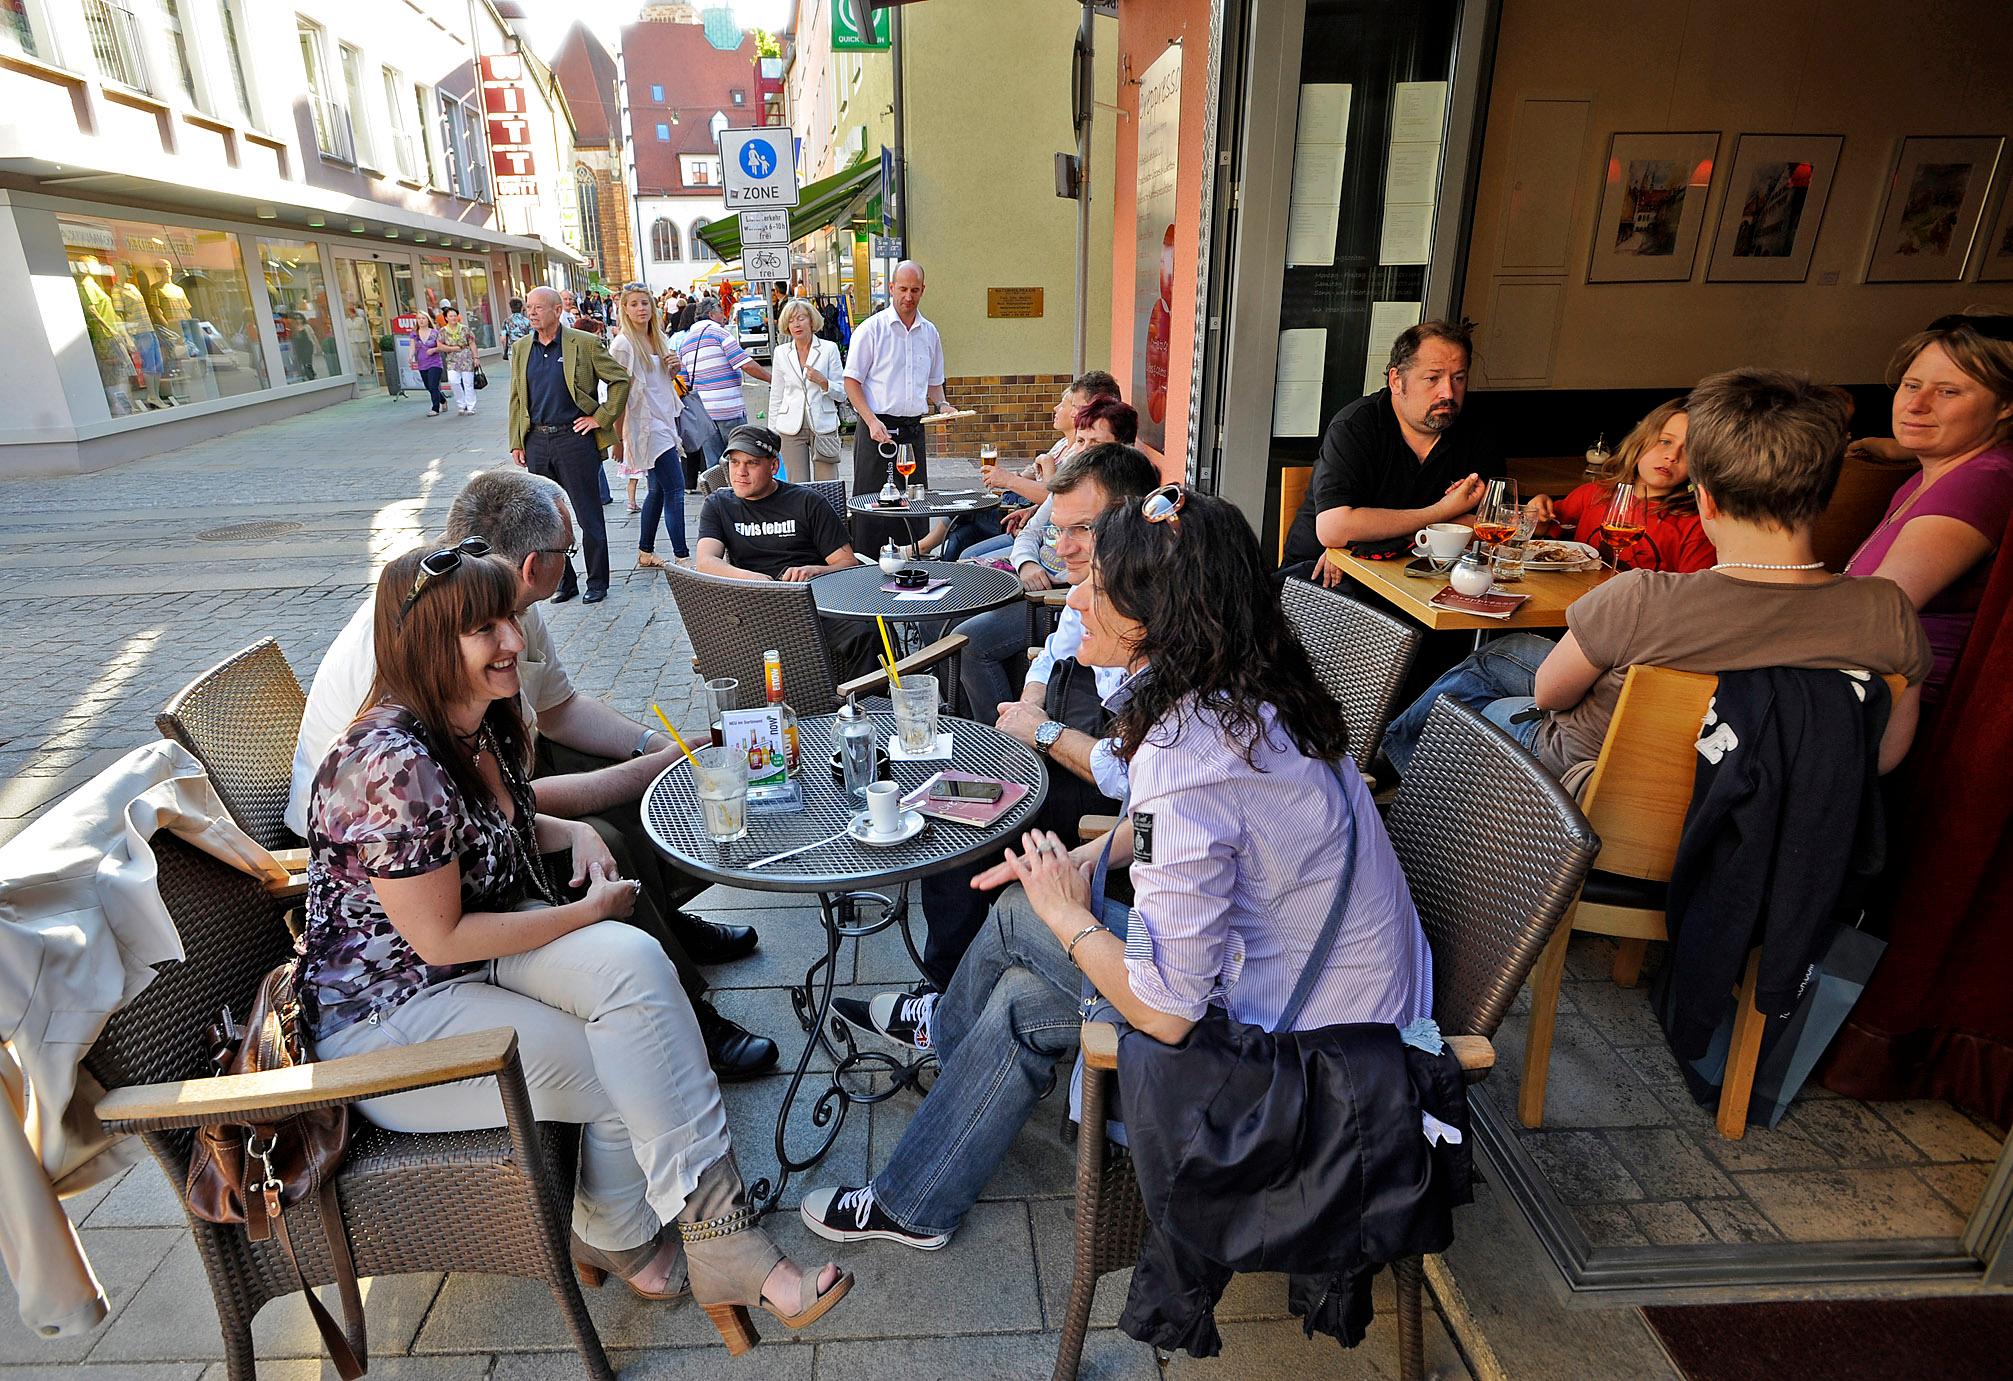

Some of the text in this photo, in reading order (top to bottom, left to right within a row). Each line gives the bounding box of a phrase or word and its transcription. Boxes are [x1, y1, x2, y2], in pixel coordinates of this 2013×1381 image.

[838, 35, 860, 43] QUICK
[489, 56, 529, 174] WITT
[743, 186, 779, 199] ZONE
[759, 232, 772, 240] frei
[759, 269, 775, 278] frei
[734, 522, 762, 537] Elvis
[769, 717, 779, 735] now
